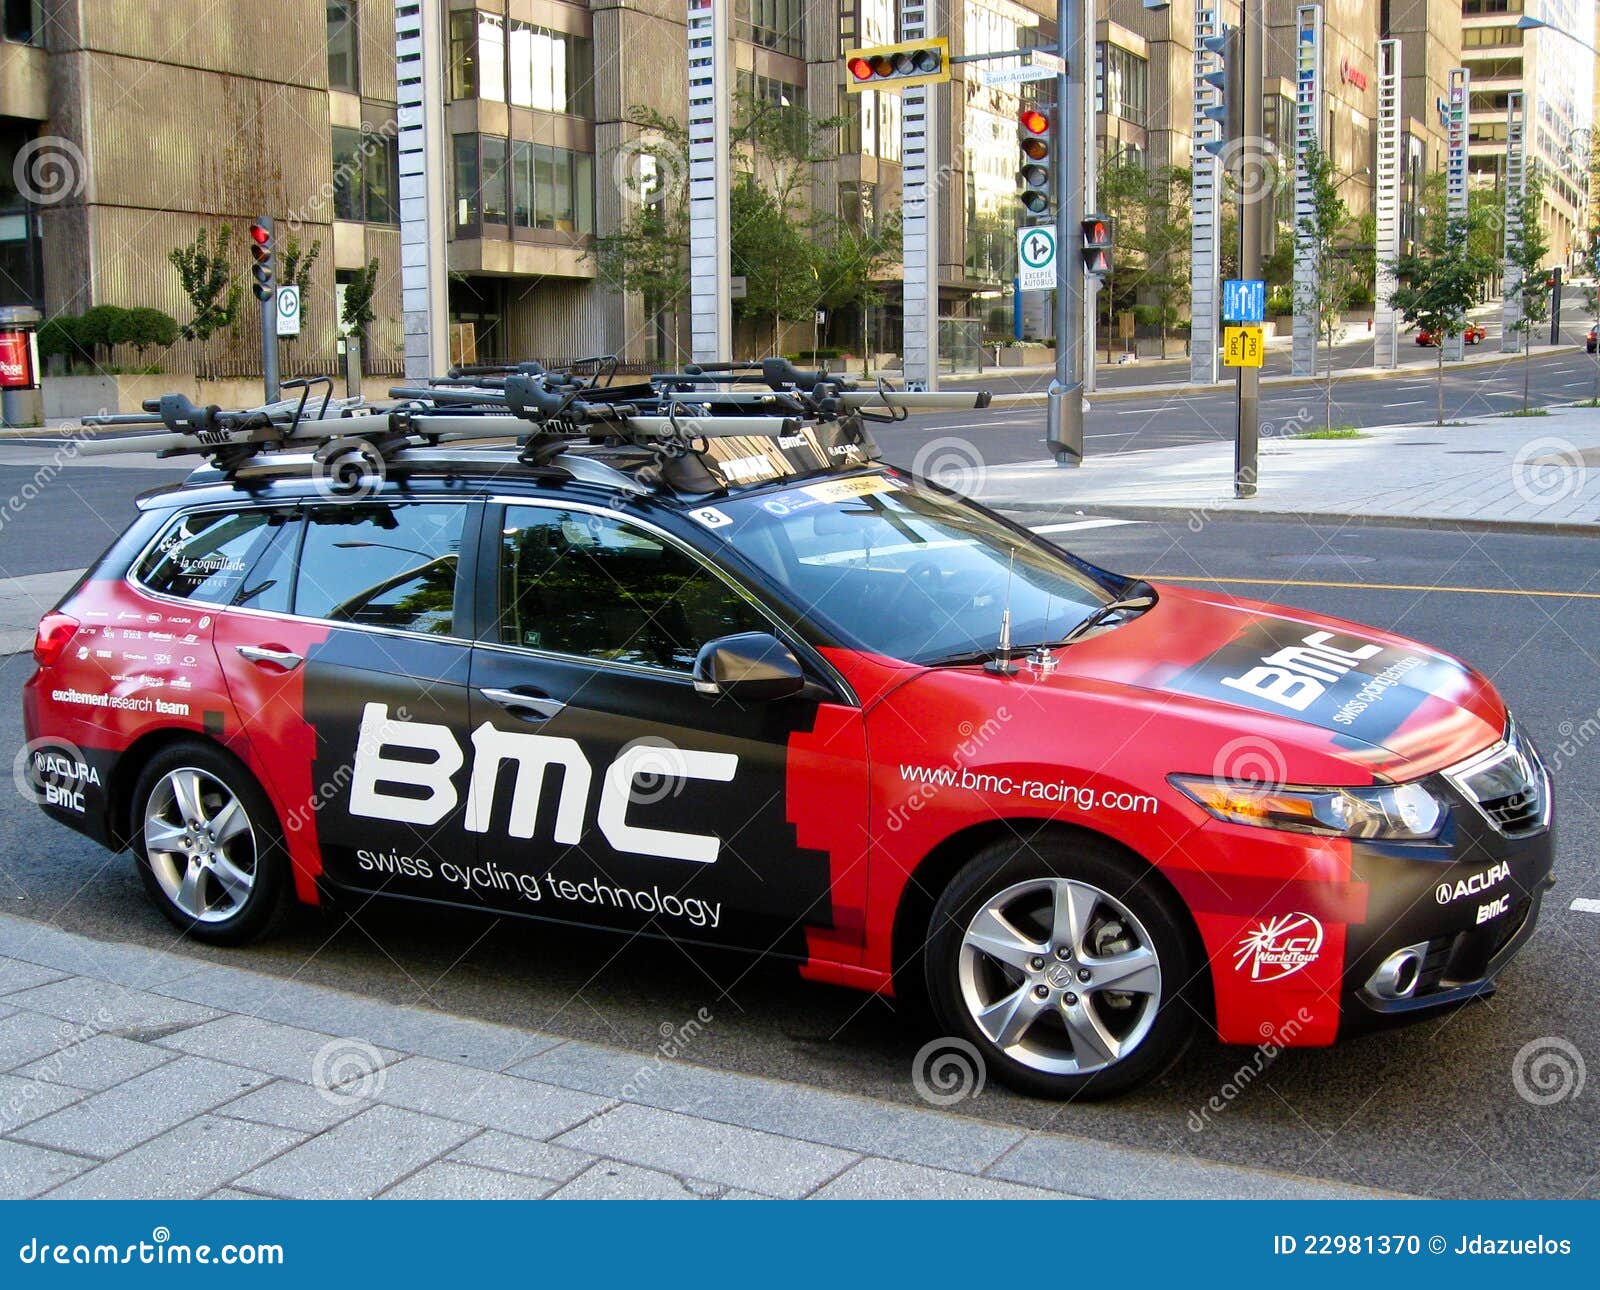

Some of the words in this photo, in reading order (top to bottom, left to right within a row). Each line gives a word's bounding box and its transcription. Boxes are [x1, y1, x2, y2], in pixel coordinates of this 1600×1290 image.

[985, 69, 1043, 85] Saint-Antoine
[700, 511, 721, 523] 8
[179, 555, 191, 568] la
[191, 556, 246, 574] coquillade
[52, 687, 109, 708] excitement
[108, 696, 153, 712] research
[155, 698, 190, 716] team
[46, 755, 101, 787] ACURA
[45, 781, 86, 813] BMC
[899, 763, 1159, 815] www.bmc-racing.com
[356, 848, 434, 879] swiss
[440, 861, 543, 902] cycling
[544, 872, 722, 929] technology
[1452, 860, 1511, 900] ACURA
[1475, 893, 1511, 925] BMC
[1254, 949, 1320, 964] WorldTour
